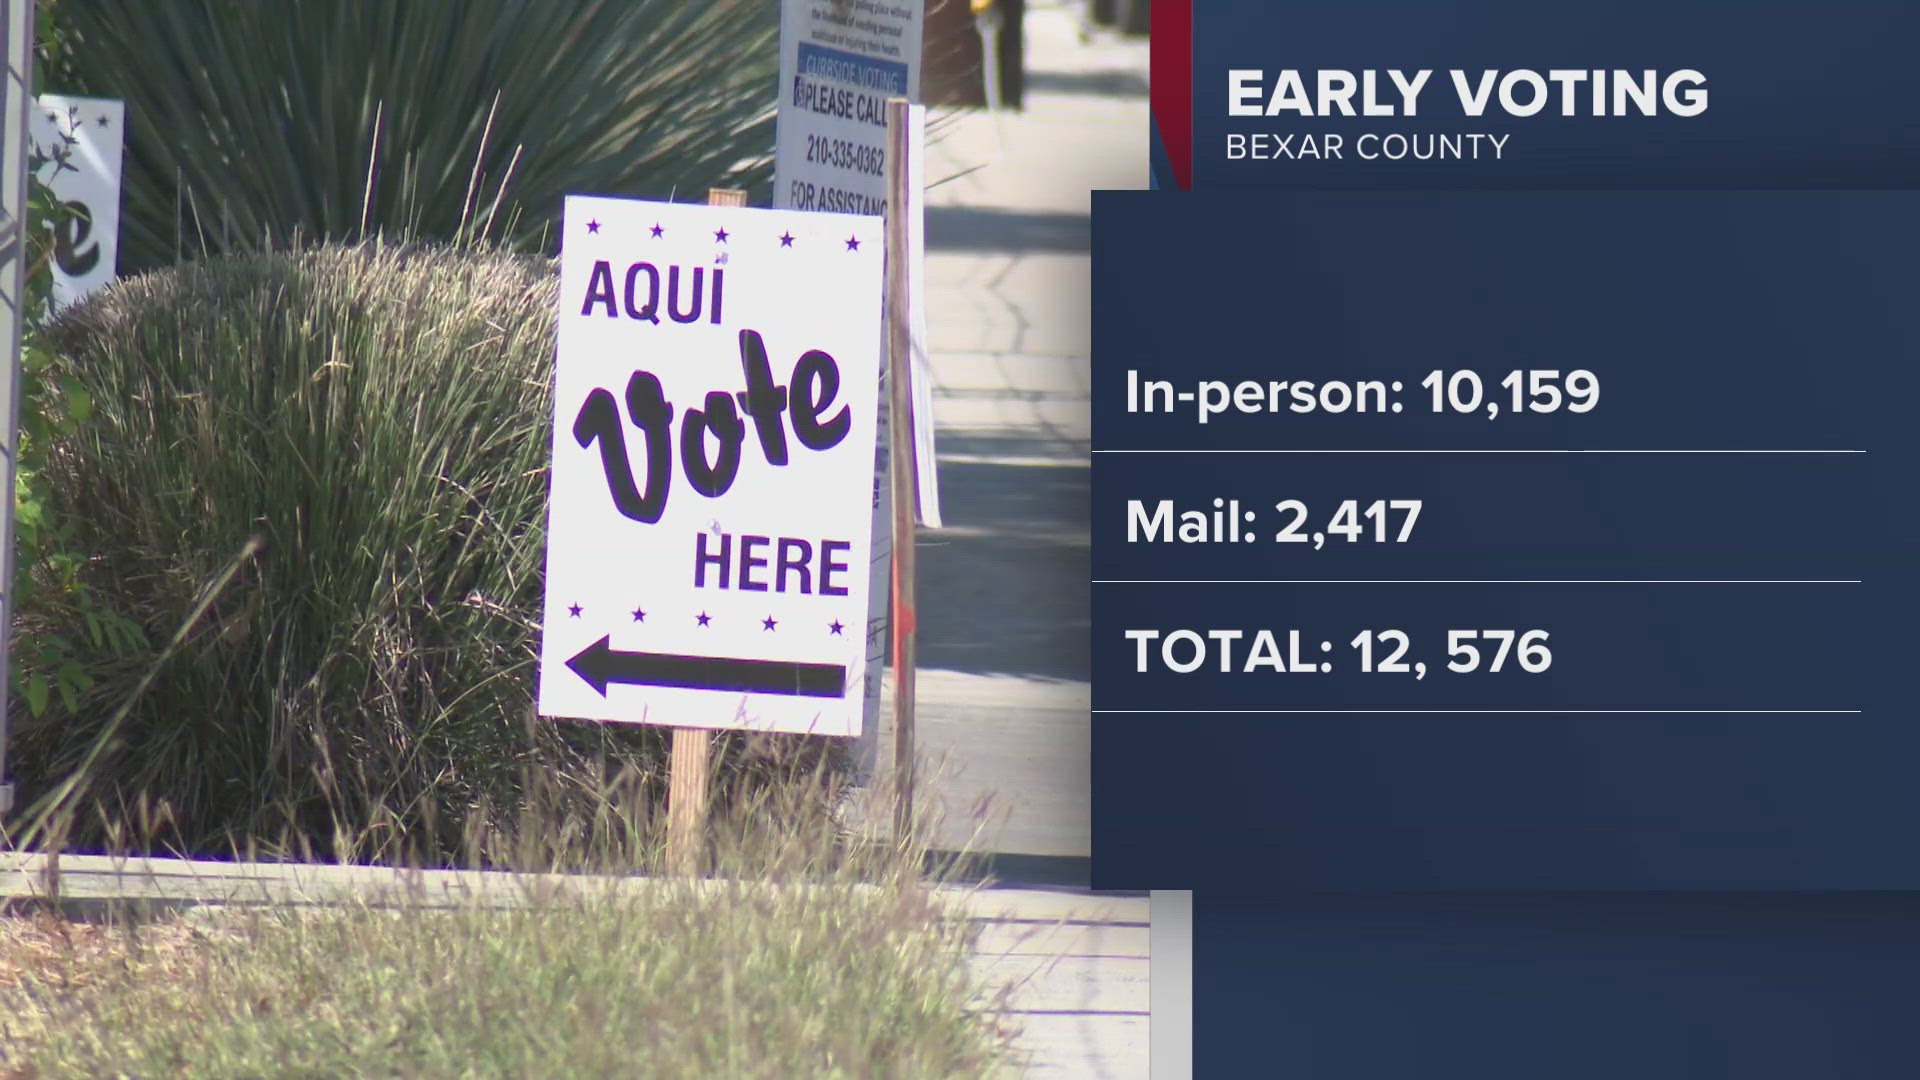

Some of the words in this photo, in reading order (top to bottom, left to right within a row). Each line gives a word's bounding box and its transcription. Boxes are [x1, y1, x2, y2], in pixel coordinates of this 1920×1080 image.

[806, 55, 857, 84] CURBSIDE
[858, 67, 899, 92] VOTING
[804, 83, 854, 119] PLEASE
[856, 94, 888, 128] CALL
[807, 134, 885, 177] 210-335-0362
[790, 180, 815, 212] FOR
[818, 187, 888, 217] ASSISTANC
[572, 328, 852, 525] Vote
[694, 532, 851, 597] HERE
